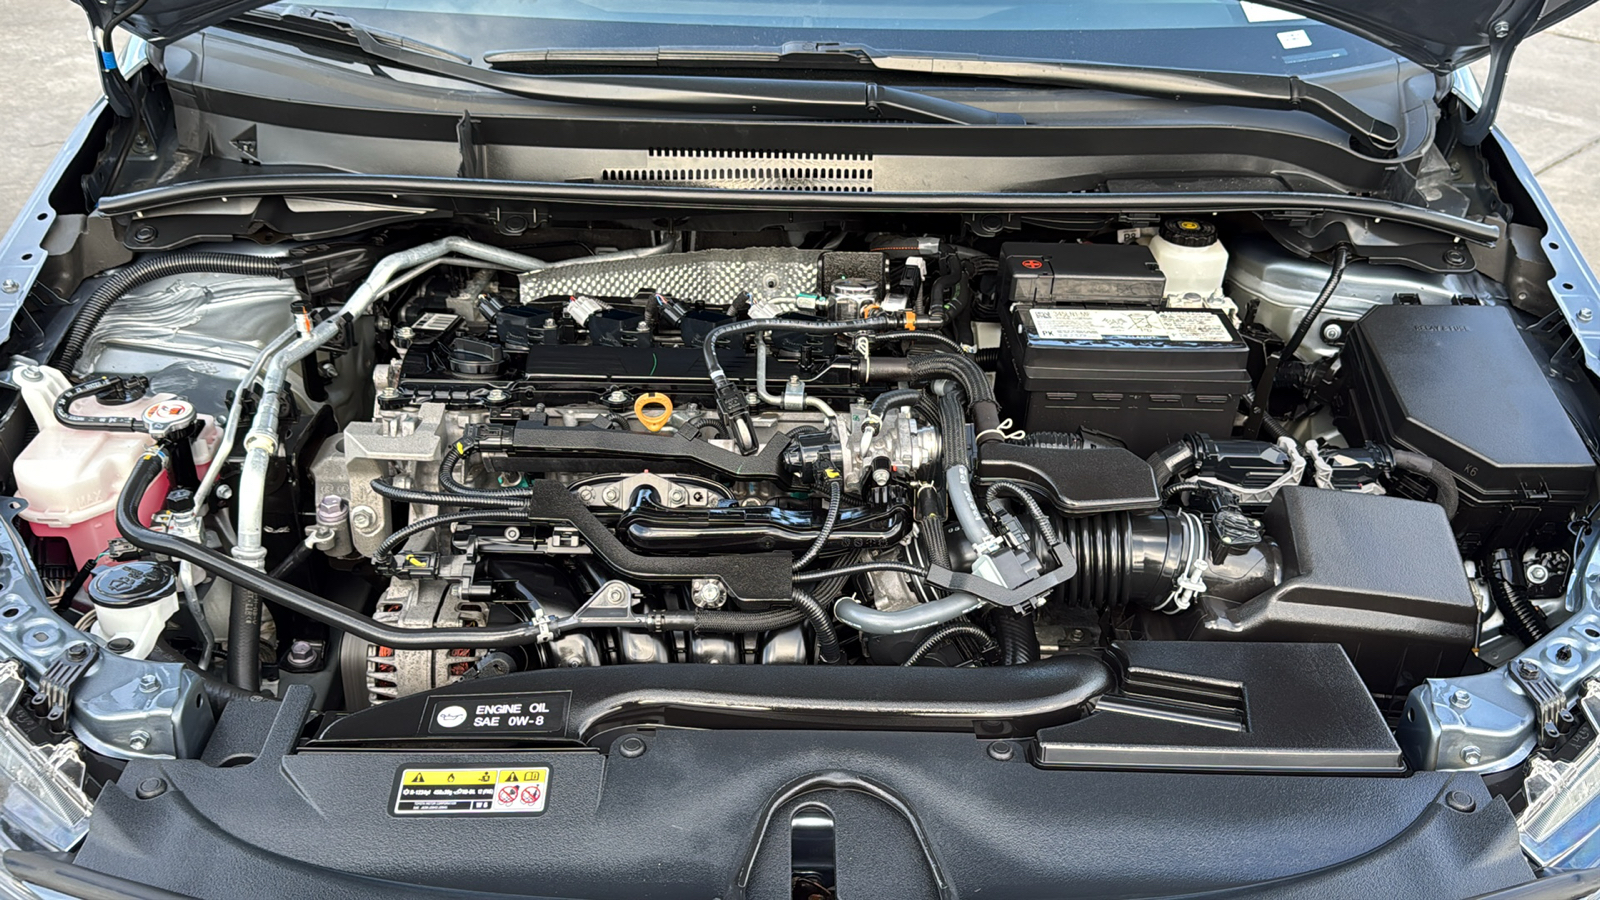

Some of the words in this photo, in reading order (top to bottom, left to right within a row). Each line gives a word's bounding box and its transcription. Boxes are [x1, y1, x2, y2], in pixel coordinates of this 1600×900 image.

[1464, 463, 1479, 477] K6
[76, 489, 103, 508] MAX
[475, 703, 522, 715] ENGINE
[529, 702, 550, 713] OIL
[473, 716, 500, 727] SAE
[507, 715, 545, 726] 0W-8
